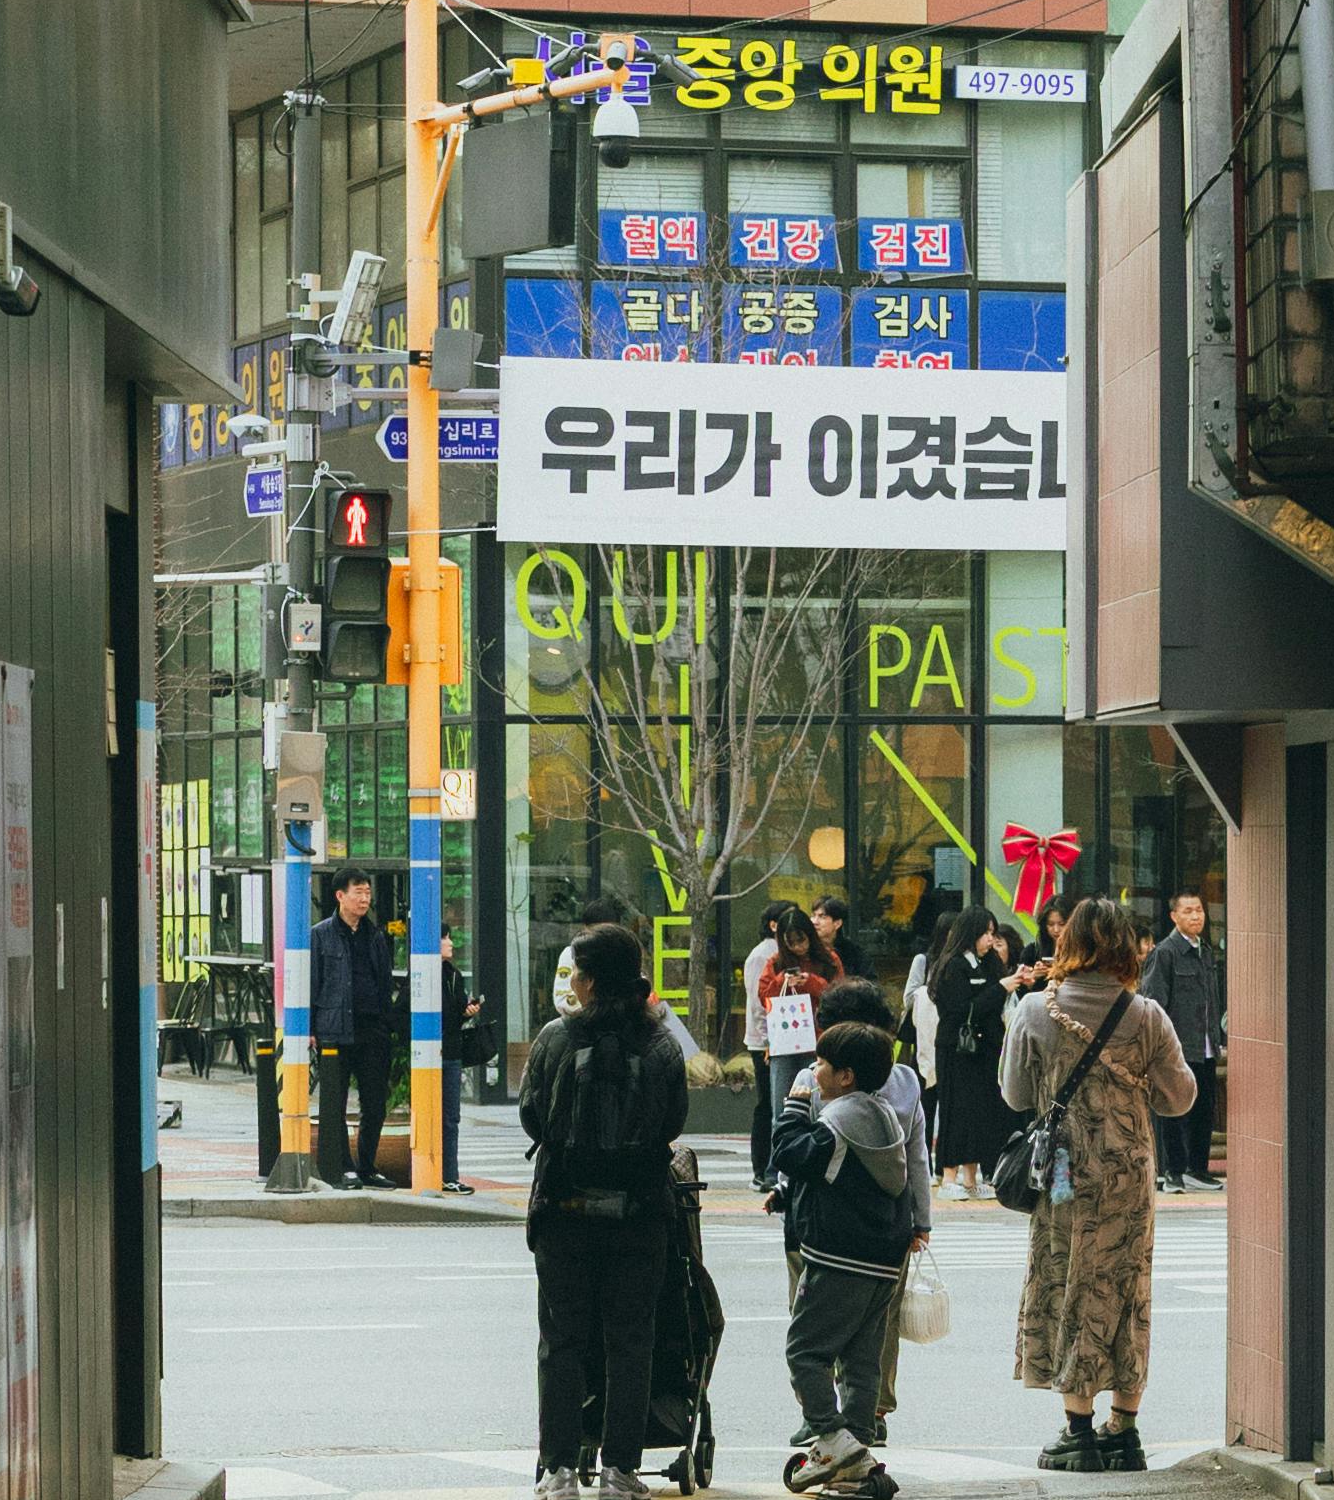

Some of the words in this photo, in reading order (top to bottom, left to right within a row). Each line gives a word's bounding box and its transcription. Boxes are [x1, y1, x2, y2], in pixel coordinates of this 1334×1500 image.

[968, 71, 1076, 99] 497-9095
[622, 214, 698, 261] 혈액
[741, 218, 824, 263] 건강
[869, 223, 952, 267] 검진
[873, 294, 953, 339] 검사
[439, 421, 496, 441] 십리로
[543, 406, 780, 498] 우리가
